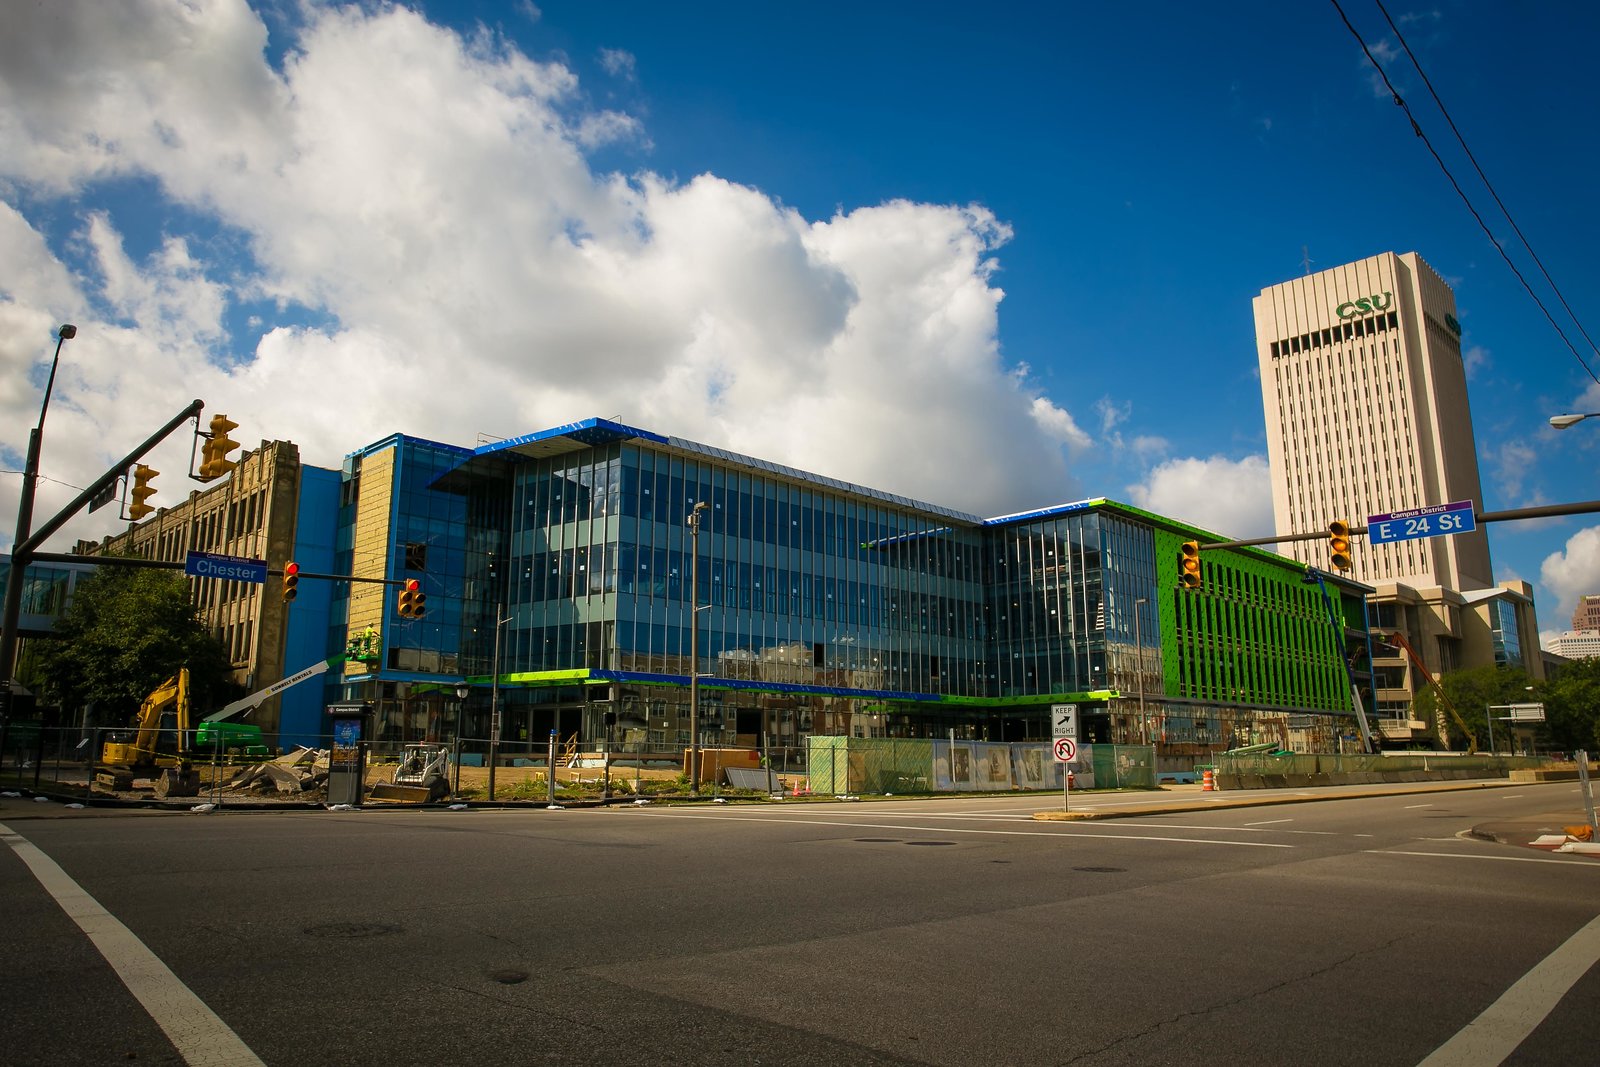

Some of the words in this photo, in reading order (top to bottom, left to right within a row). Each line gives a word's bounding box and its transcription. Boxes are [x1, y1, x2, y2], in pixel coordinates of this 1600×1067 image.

[1336, 291, 1392, 320] CSU
[1390, 509, 1419, 519] Campus
[1420, 505, 1447, 515] District
[1379, 523, 1397, 539] E.
[1405, 517, 1431, 535] 24
[1438, 514, 1462, 530] St
[206, 553, 229, 561] Campus
[230, 556, 250, 564] District
[196, 560, 257, 579] Chester
